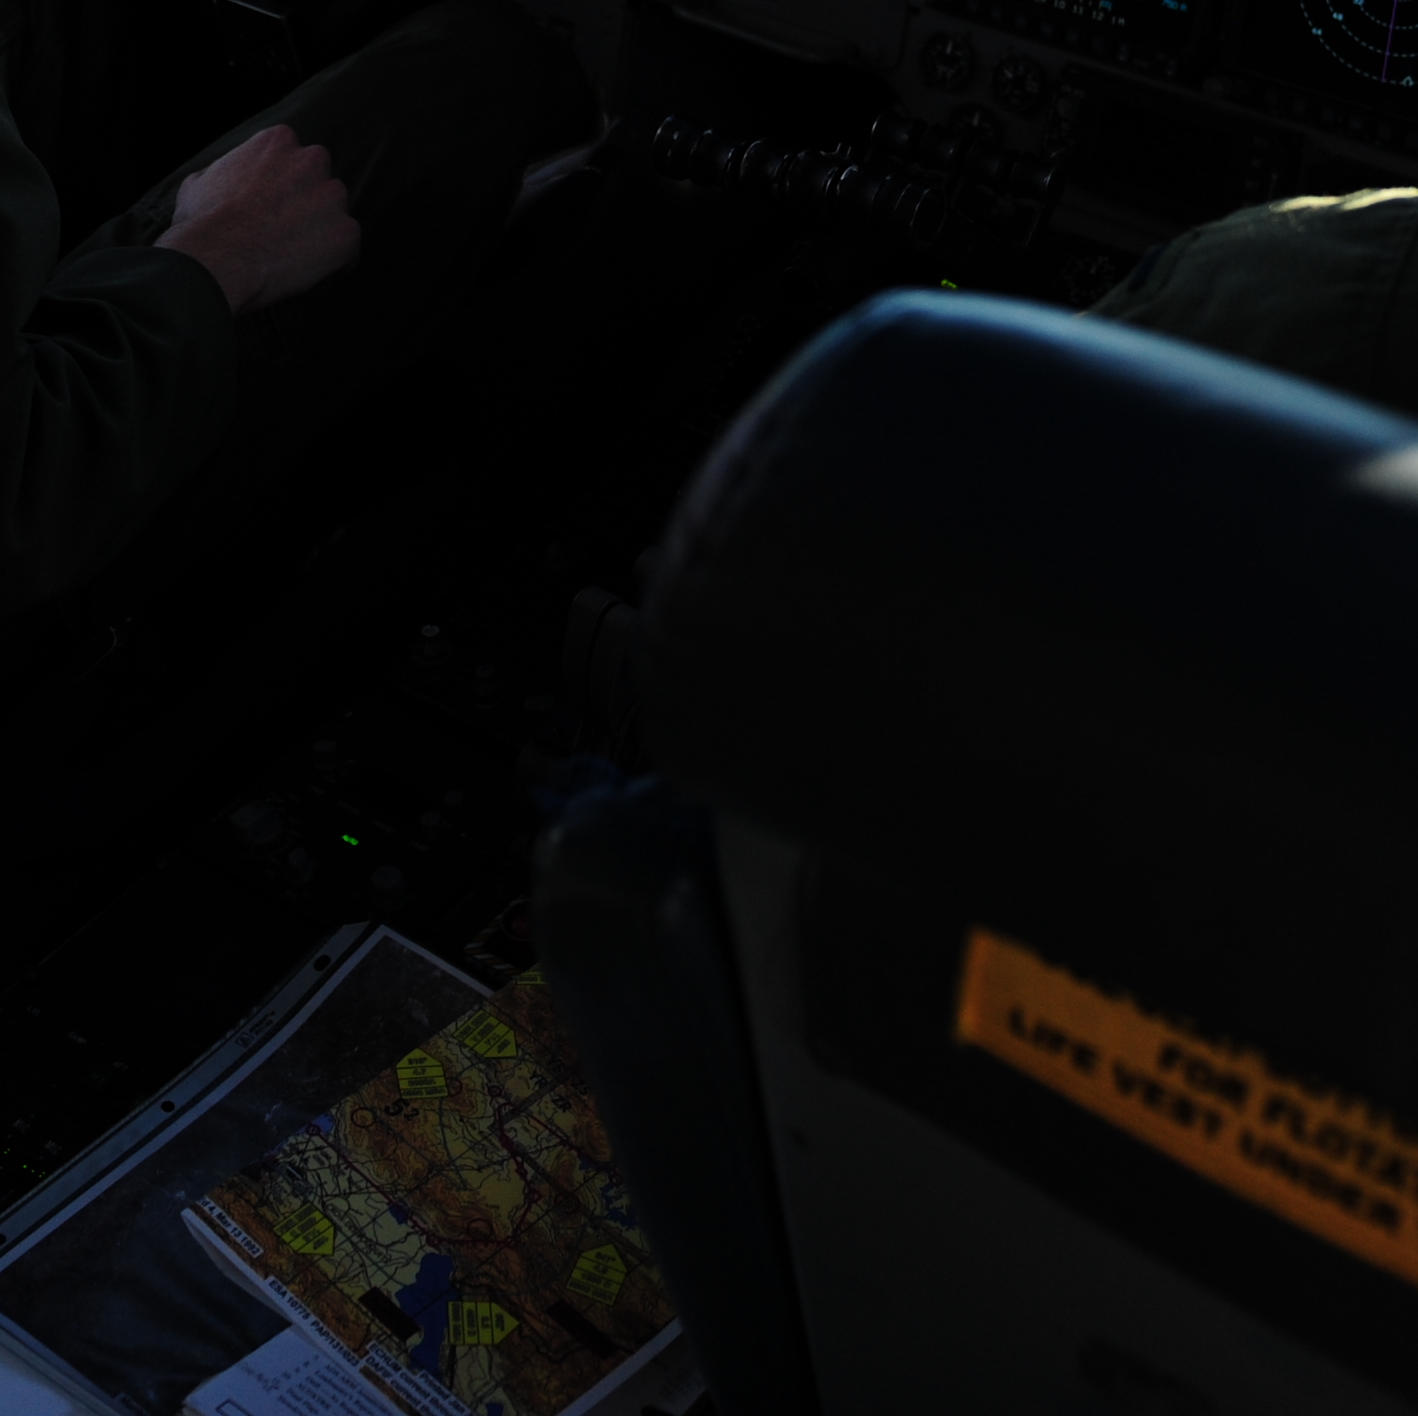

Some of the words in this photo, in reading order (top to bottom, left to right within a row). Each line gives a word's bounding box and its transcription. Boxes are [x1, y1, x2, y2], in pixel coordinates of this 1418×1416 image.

[1157, 1041, 1248, 1108] FOR
[551, 1095, 572, 1113] ZR
[1009, 1003, 1098, 1076] LIFE
[1113, 1059, 1225, 1142] VEST
[1239, 1129, 1406, 1235] UNDER
[215, 1212, 232, 1228] Mar
[230, 1226, 242, 1239] 13
[240, 1235, 261, 1257] 1992
[269, 1280, 288, 1300] ESA
[285, 1295, 311, 1322] 10775
[310, 1315, 359, 1368] PAP/131/023
[365, 1356, 391, 1379] DAFIF
[389, 1378, 422, 1407] current
[370, 1342, 402, 1374] ECHUM
[399, 1371, 431, 1400] current
[420, 1372, 450, 1400] Printed
